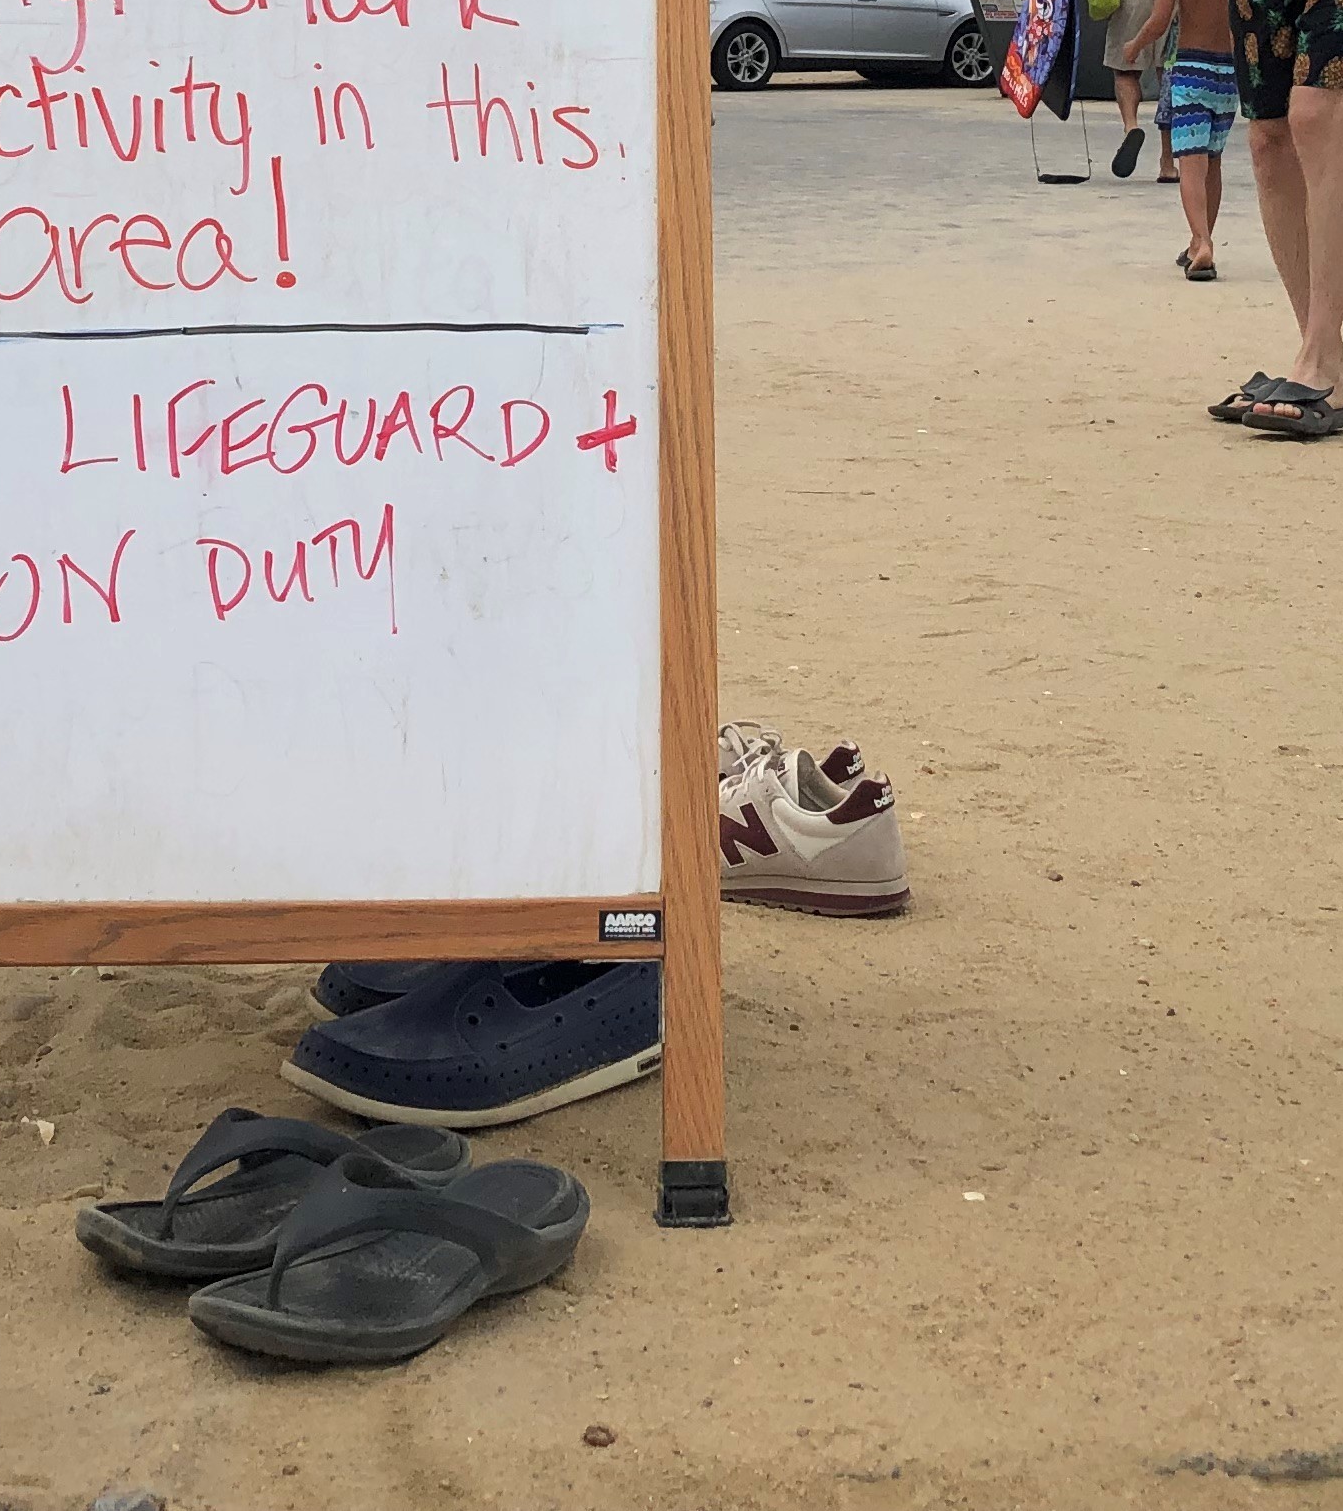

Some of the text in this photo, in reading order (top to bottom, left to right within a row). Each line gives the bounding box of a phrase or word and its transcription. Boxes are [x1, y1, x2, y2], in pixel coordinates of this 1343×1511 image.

[313, 63, 375, 150] in
[60, 379, 551, 479] LIFEGUARD
[196, 503, 398, 635] DUTY
[605, 913, 656, 927] AARCO
